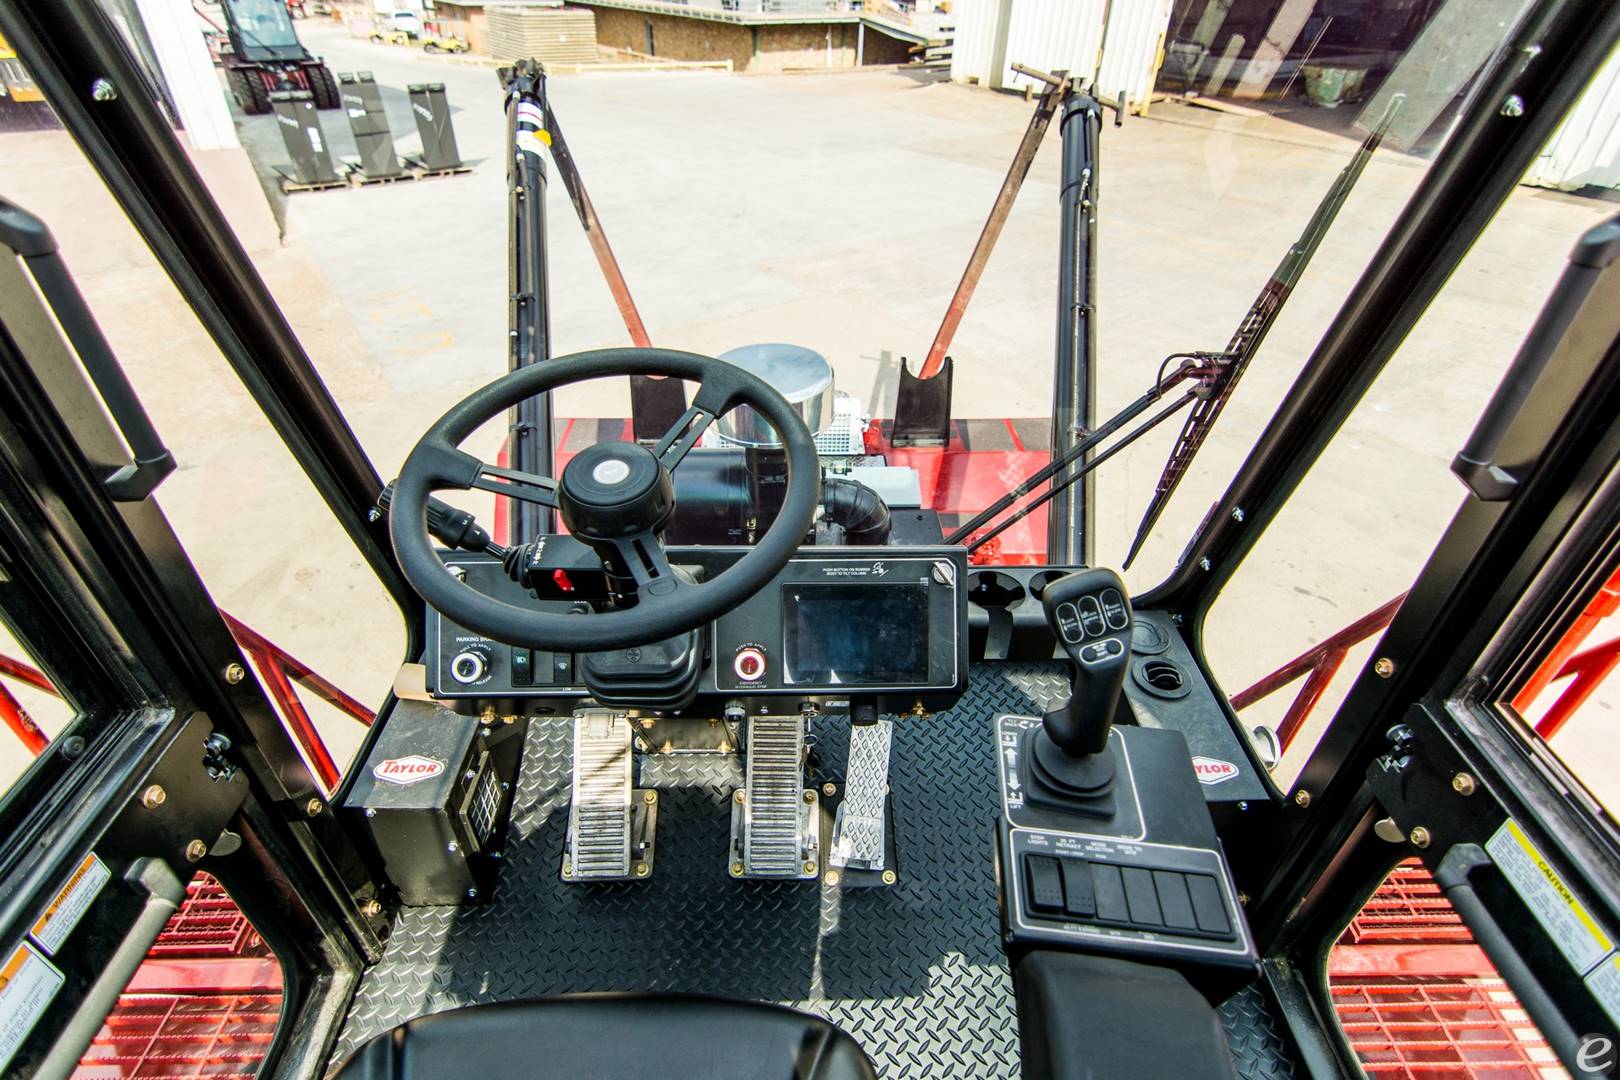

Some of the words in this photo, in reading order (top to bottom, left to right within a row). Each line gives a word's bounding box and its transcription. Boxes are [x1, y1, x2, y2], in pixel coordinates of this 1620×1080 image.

[478, 643, 492, 651] APPLY
[735, 644, 747, 652] PUSH
[383, 761, 438, 773] TAYLOR
[1194, 764, 1231, 774] YLOR
[53, 868, 86, 908] WARNING
[1538, 861, 1574, 905] CAUTION
